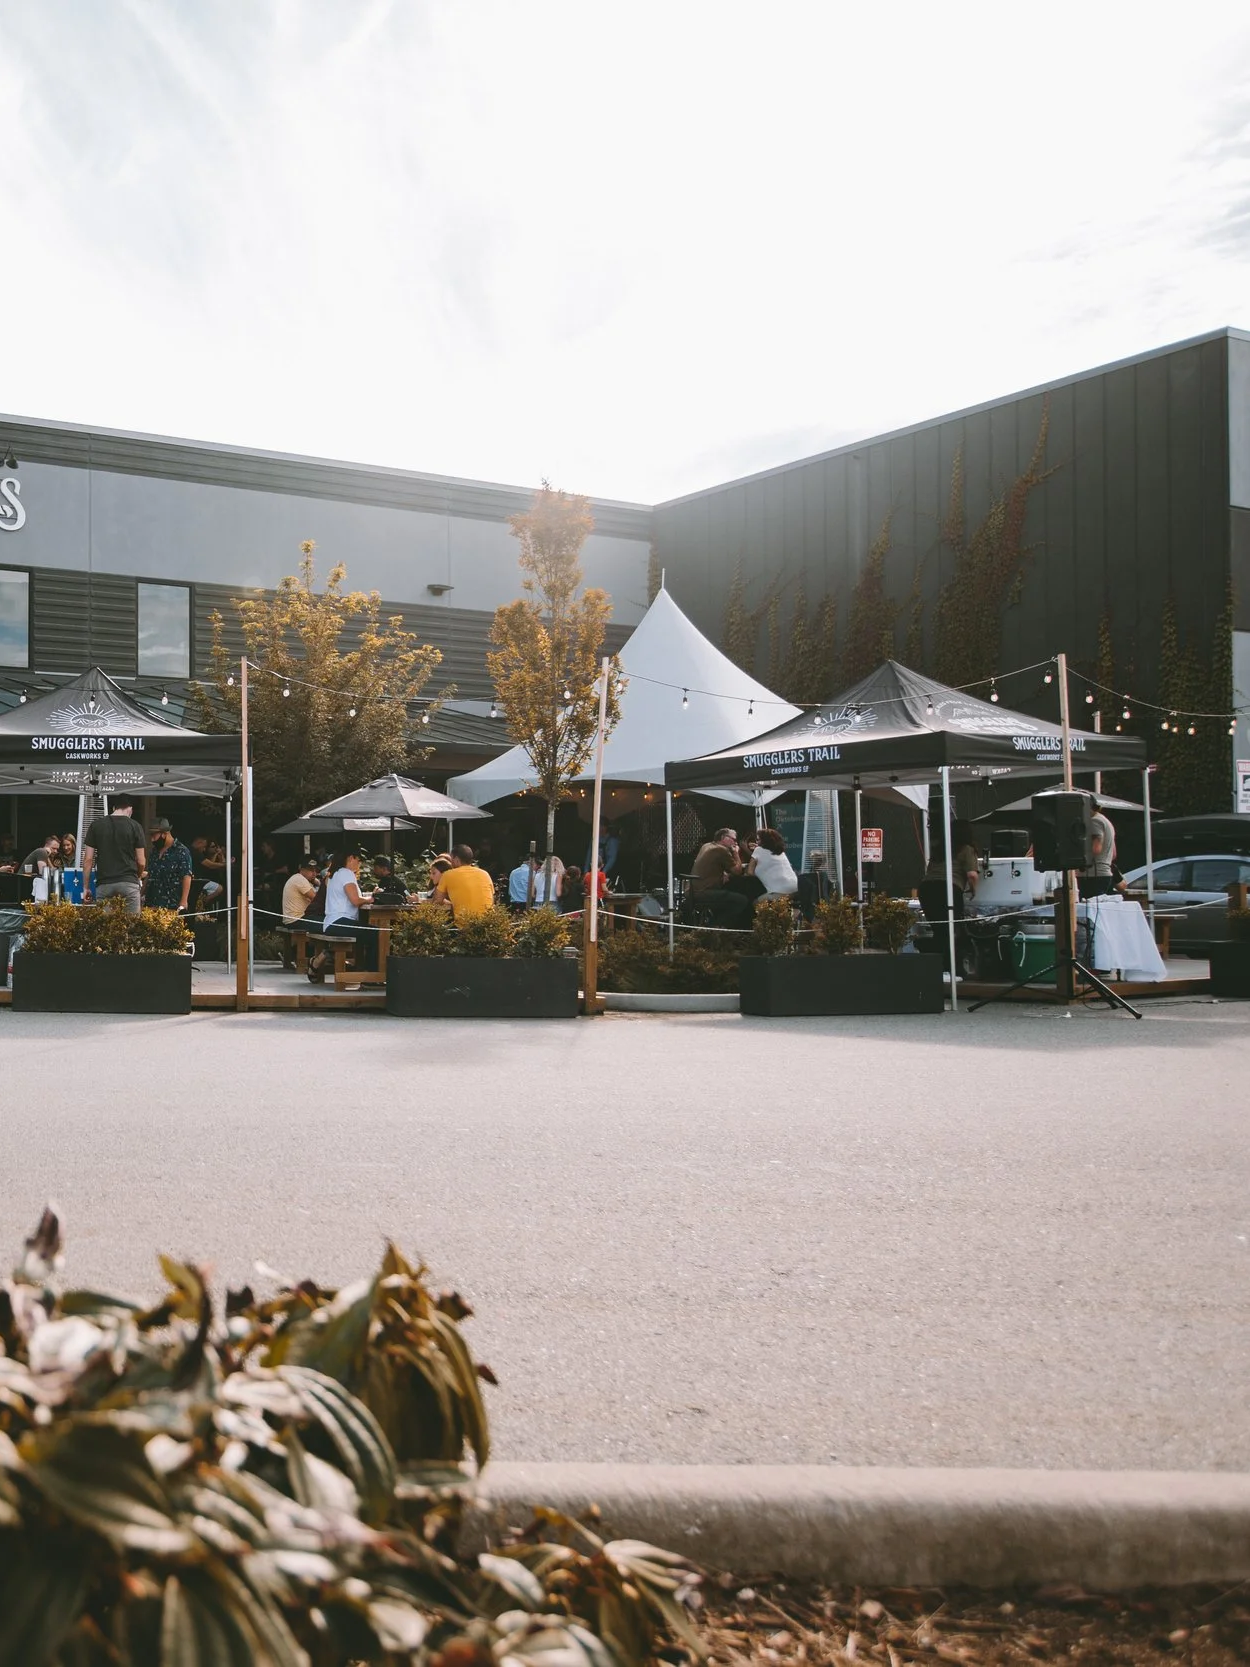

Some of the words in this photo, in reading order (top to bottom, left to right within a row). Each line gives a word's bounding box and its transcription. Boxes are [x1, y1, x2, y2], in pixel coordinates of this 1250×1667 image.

[31, 737, 105, 750] SMUGGLERS
[109, 738, 145, 750] TRAIL
[1012, 736, 1061, 750] SMUGGLERS
[743, 749, 805, 769] SMUGGLERS
[808, 746, 841, 762] TRAIL
[771, 766, 802, 775] CASKWORKS
